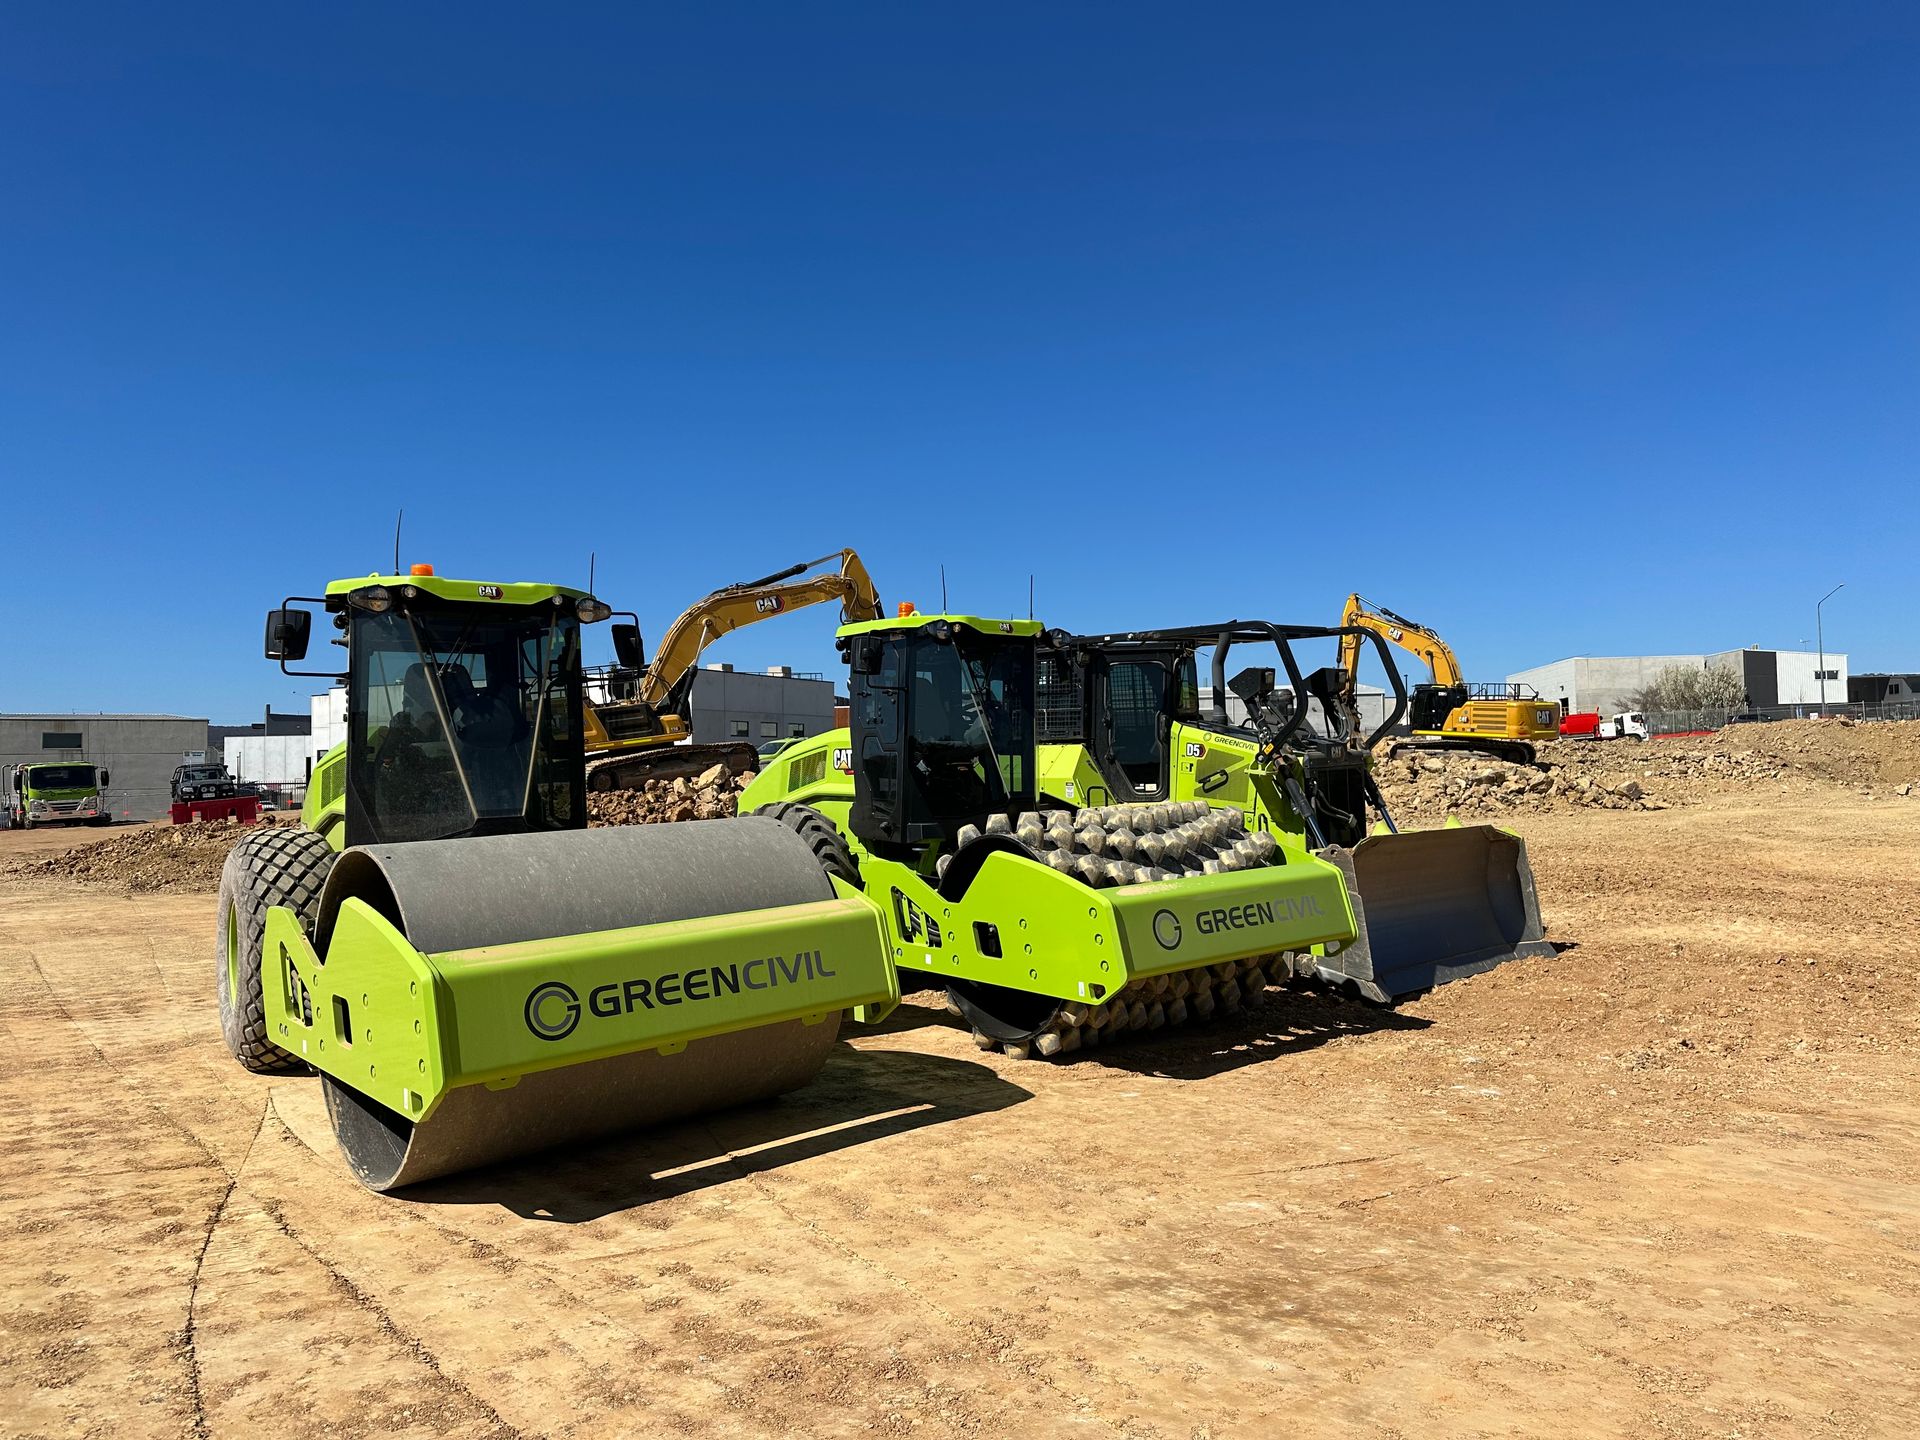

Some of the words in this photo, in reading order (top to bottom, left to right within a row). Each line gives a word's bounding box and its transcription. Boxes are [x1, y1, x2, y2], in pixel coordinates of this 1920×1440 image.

[479, 585, 496, 597] CAT
[755, 595, 778, 613] CAT
[1388, 627, 1402, 640] CAT
[1537, 711, 1550, 724] CAT
[1186, 743, 1200, 757] D5
[1214, 736, 1256, 751] GREENCIVIL
[833, 749, 852, 770] CAT
[1196, 895, 1325, 935] GREENCIVIL
[588, 950, 836, 1018] GREENCIVIL
